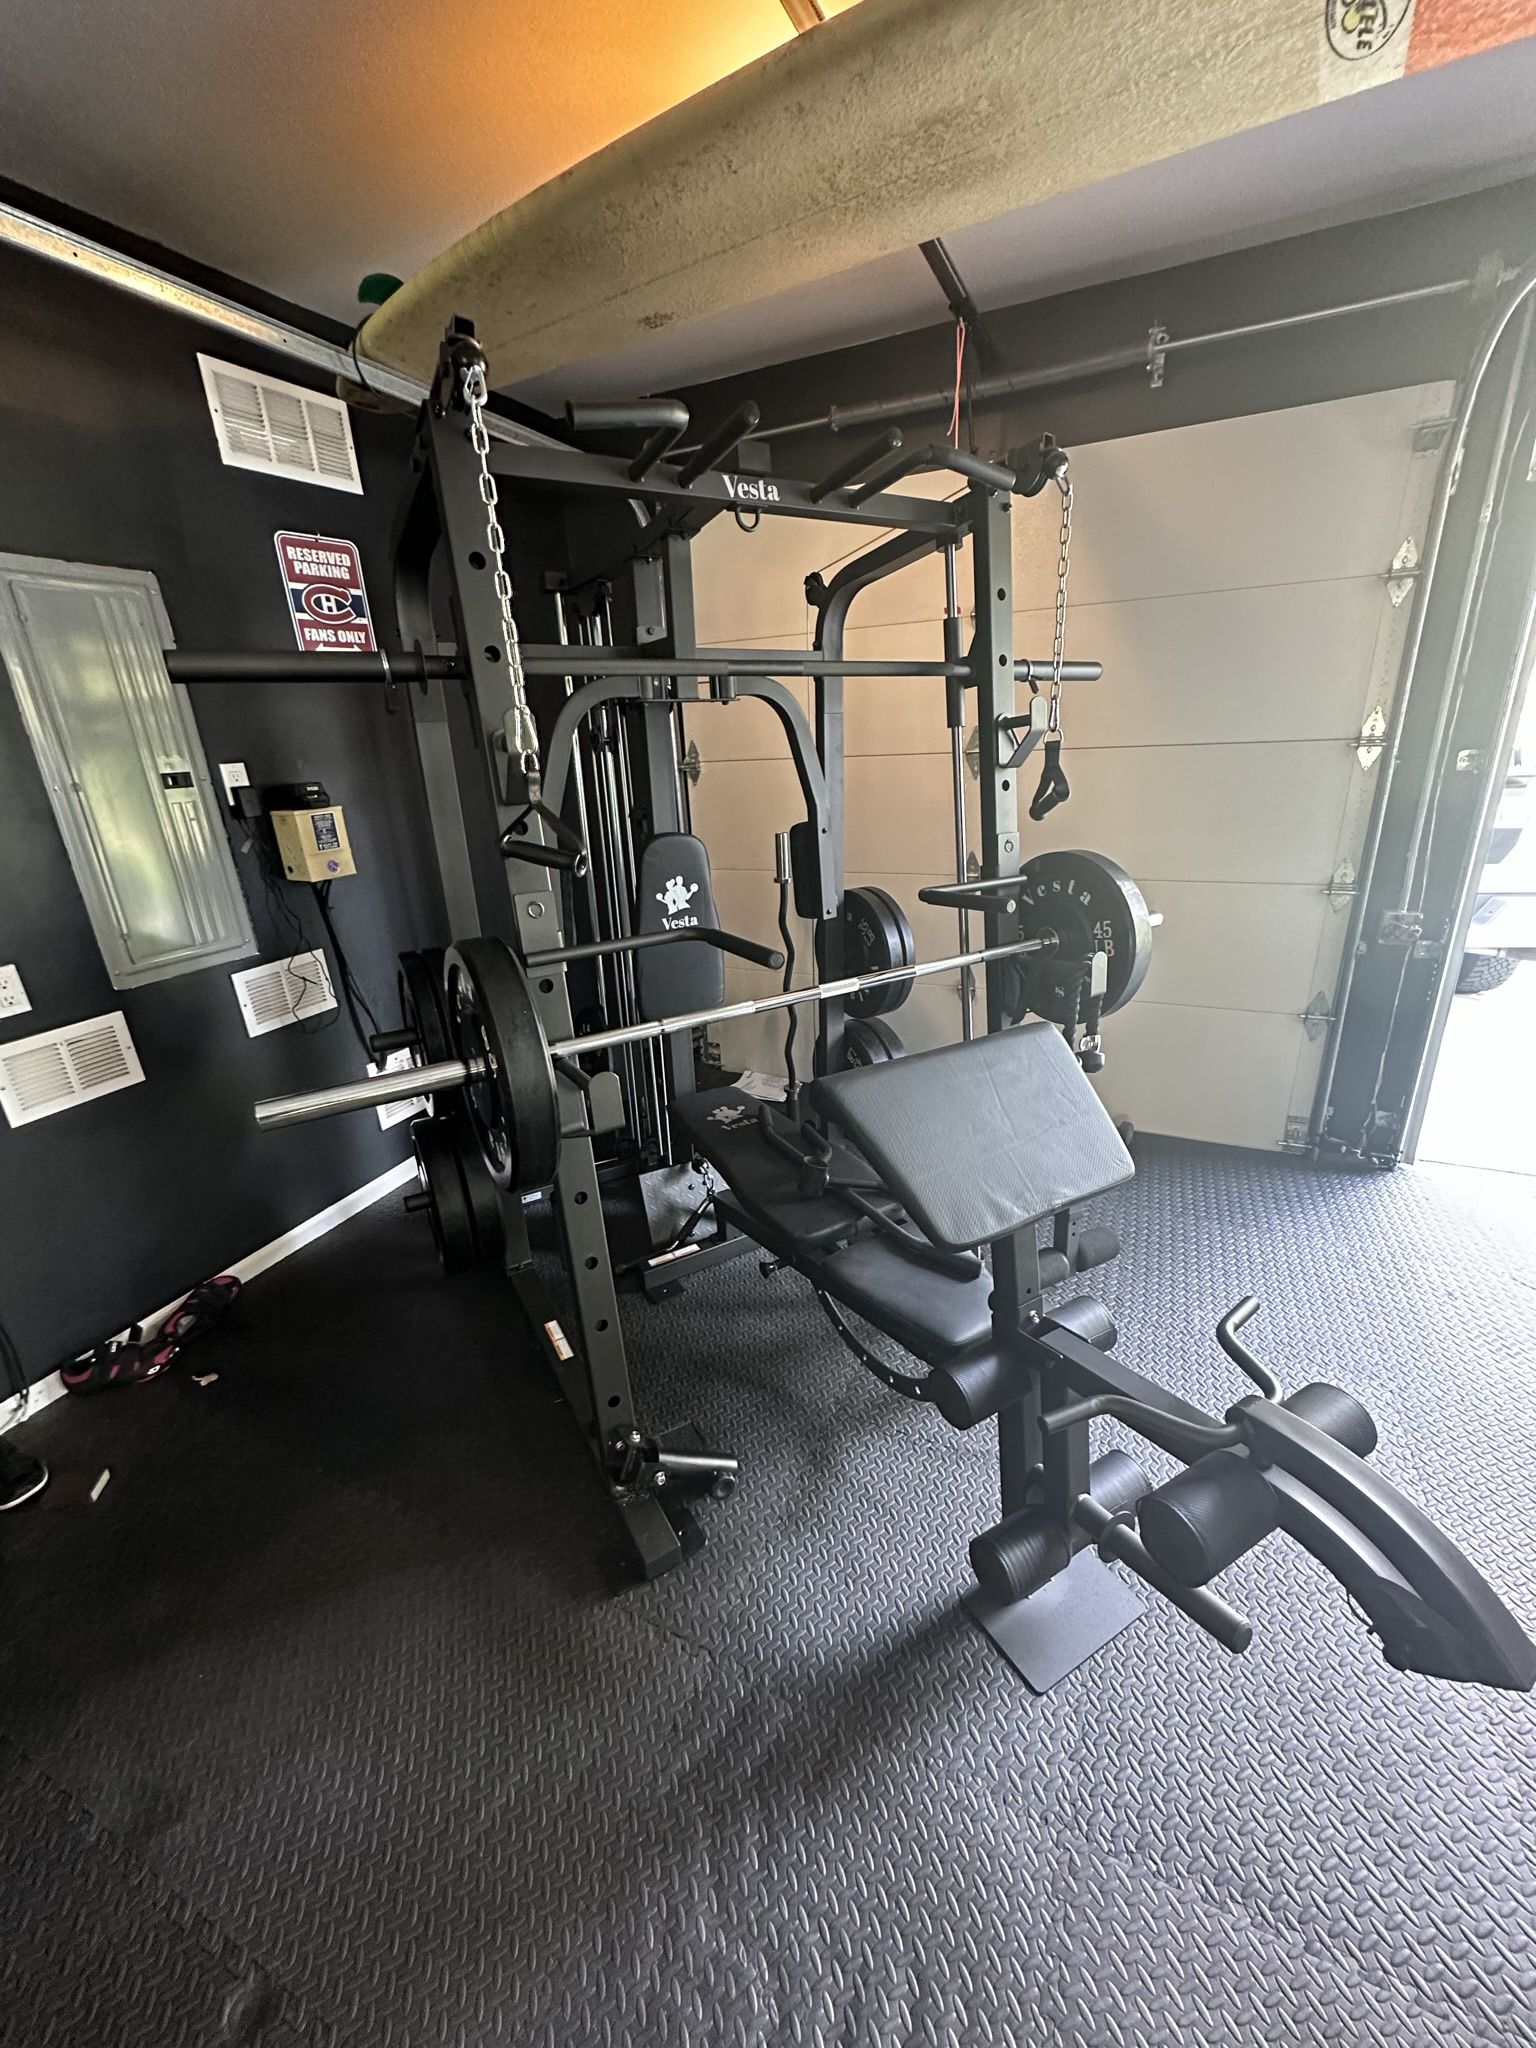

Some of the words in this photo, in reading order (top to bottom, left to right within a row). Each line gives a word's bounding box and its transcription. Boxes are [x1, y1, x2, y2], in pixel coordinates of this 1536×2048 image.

[722, 474, 780, 501] Vesta
[286, 546, 351, 566] RESERVED
[293, 561, 350, 580] PARKING
[303, 627, 337, 644] FANS
[337, 629, 366, 644] ONLY
[1021, 879, 1092, 906] Vesta
[661, 915, 699, 931] Vesta
[1093, 920, 1112, 939] 45
